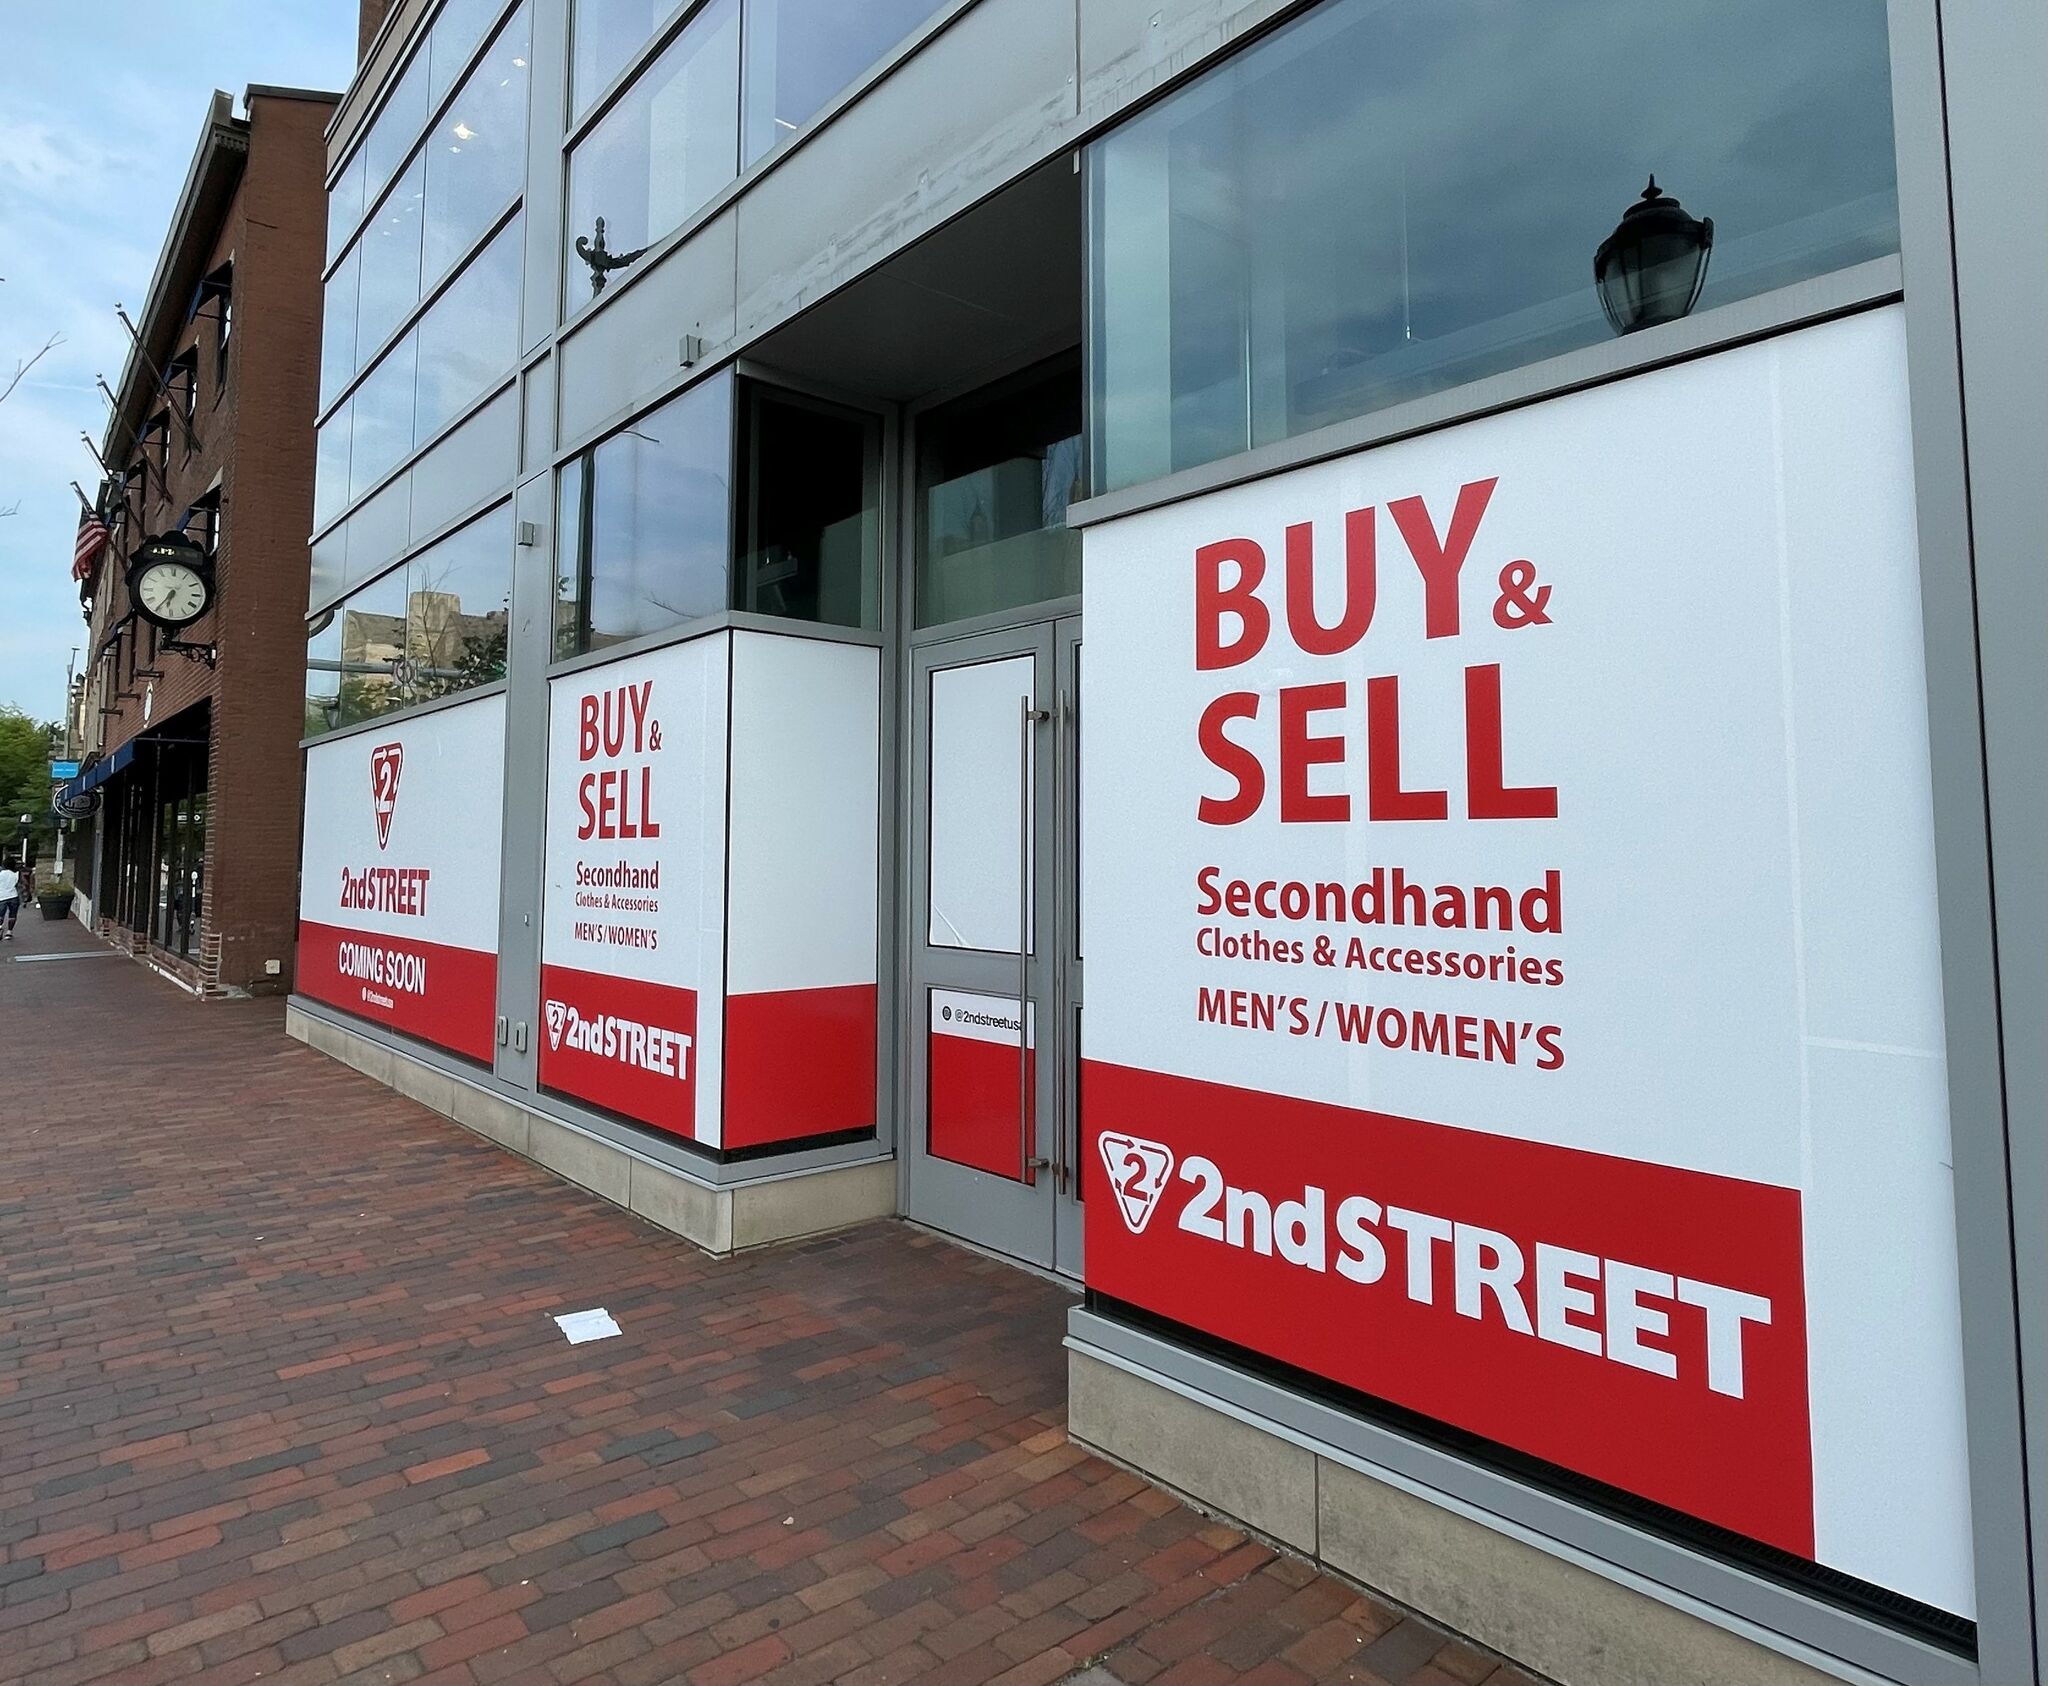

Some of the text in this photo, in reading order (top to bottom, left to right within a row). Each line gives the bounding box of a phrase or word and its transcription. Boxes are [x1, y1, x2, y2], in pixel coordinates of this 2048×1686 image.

[1195, 476, 1553, 671] BUY &
[579, 680, 662, 762] BUY &
[1196, 662, 1559, 826] SELL
[577, 766, 660, 841] SELL
[339, 866, 430, 917] 2ndSTREET
[575, 891, 659, 913] Clothes & Accessories
[576, 860, 659, 889] Secondhand
[1196, 866, 1562, 934] Secondhand
[338, 941, 426, 995] COMING SOON
[1196, 926, 1565, 986] Clothes & Accessories
[565, 1006, 692, 1081] 2ndSTREET
[1177, 1154, 1772, 1400] 2ndSTREET
